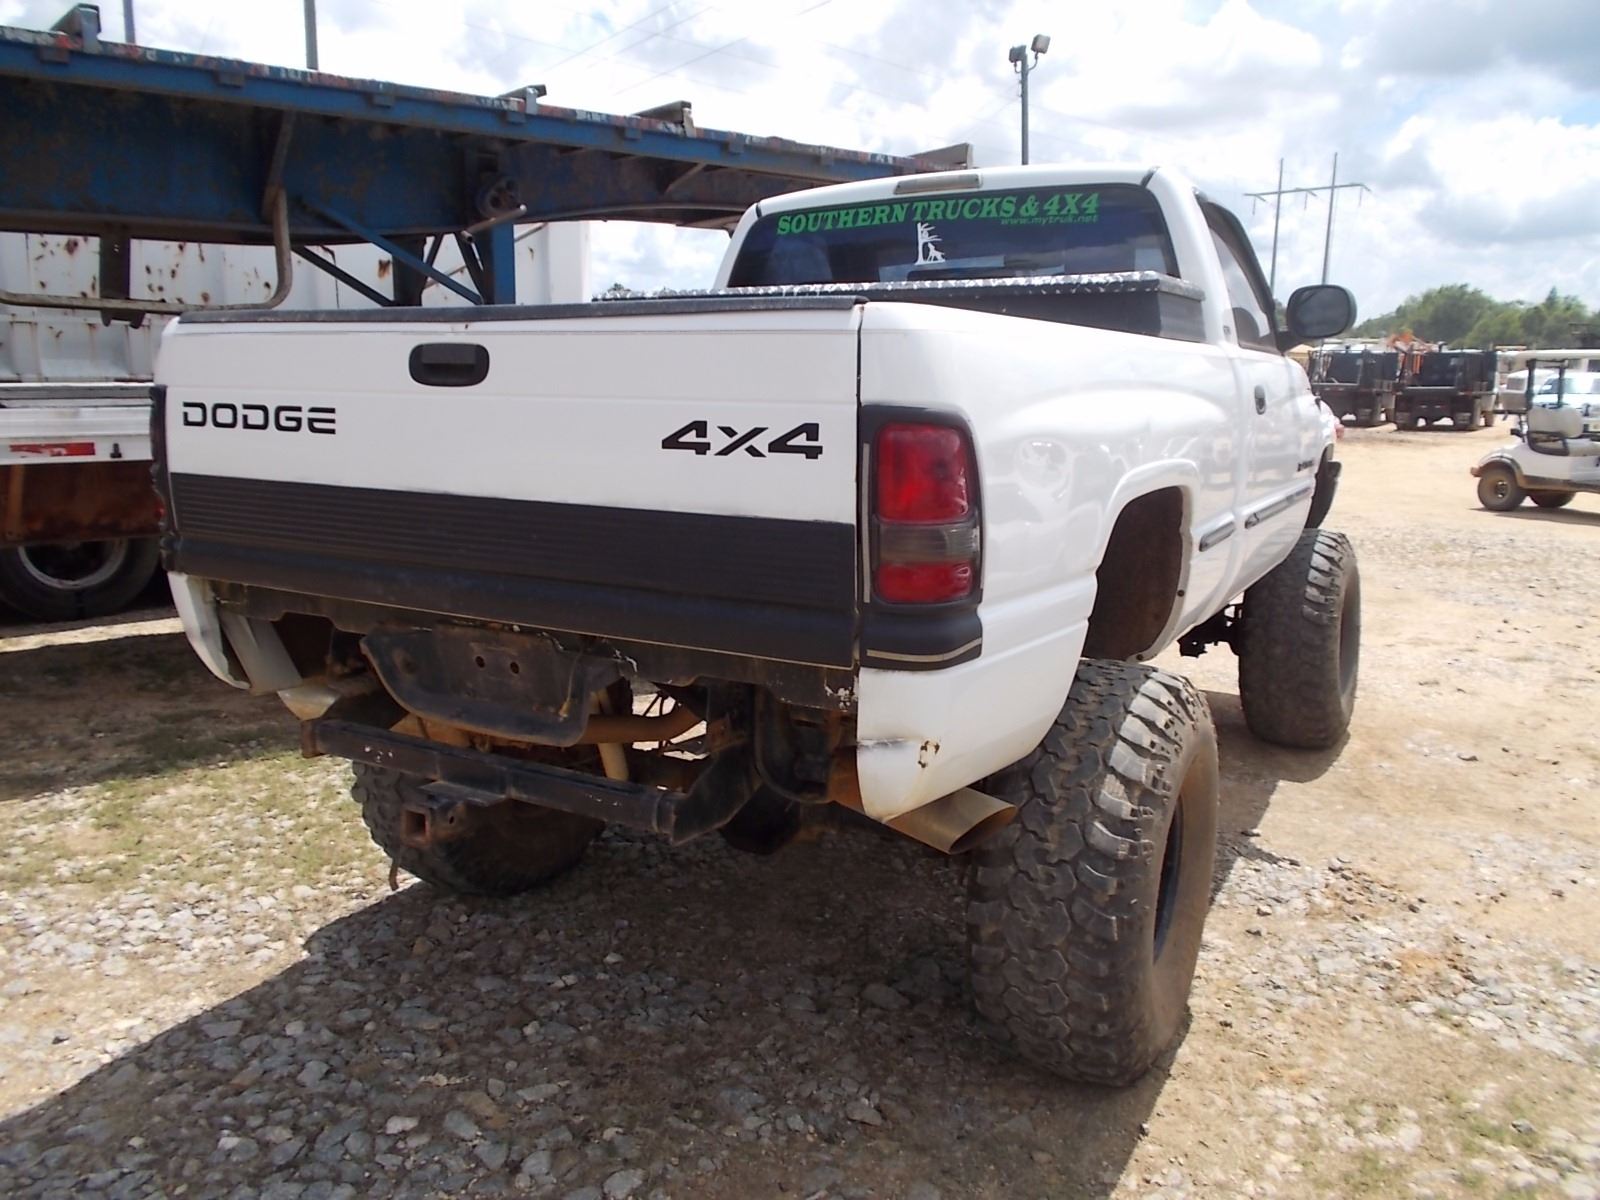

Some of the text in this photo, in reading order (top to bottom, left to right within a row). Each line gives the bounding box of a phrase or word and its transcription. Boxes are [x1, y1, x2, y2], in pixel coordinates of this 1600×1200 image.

[776, 193, 1099, 235] SOUTHERN TRUCKS & 4X4
[183, 402, 336, 434] DODGE
